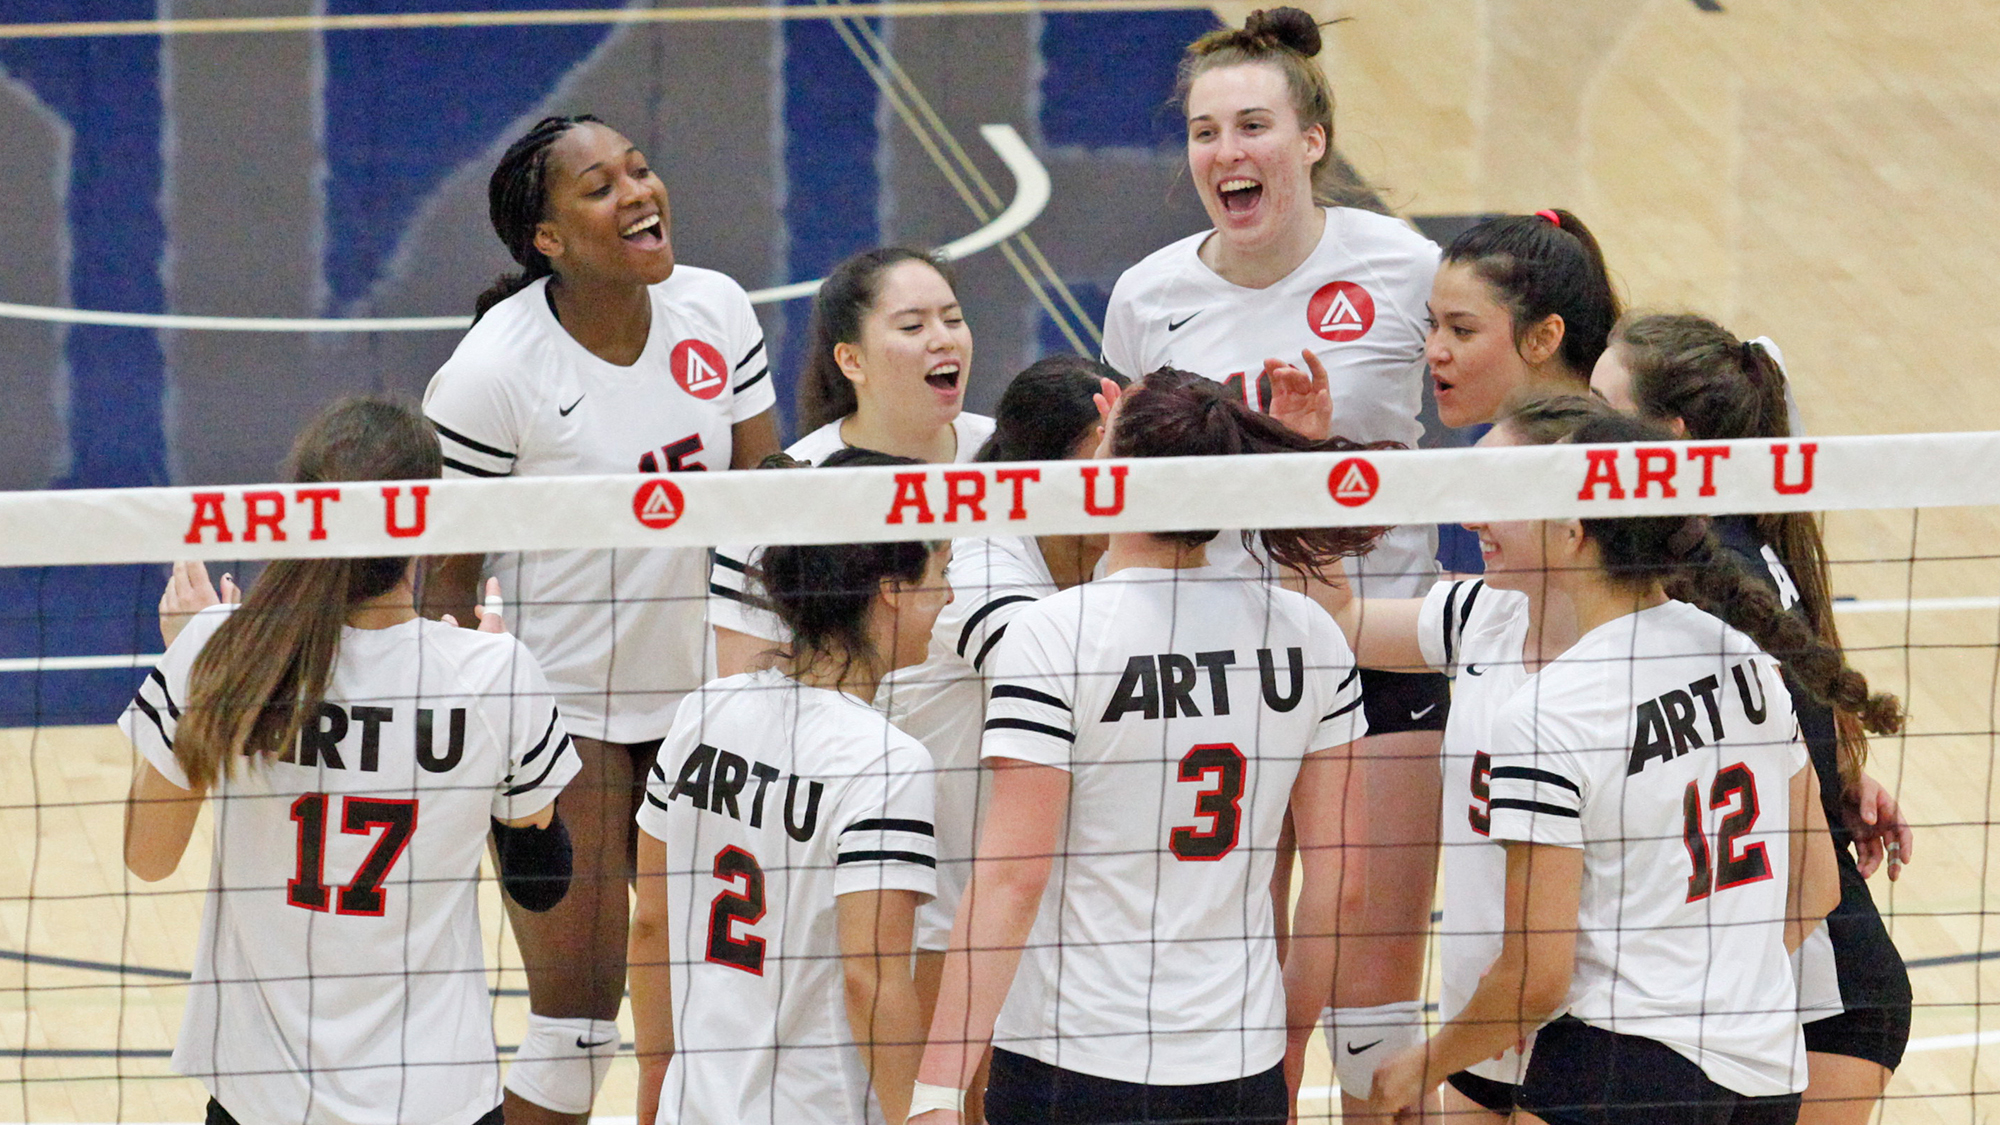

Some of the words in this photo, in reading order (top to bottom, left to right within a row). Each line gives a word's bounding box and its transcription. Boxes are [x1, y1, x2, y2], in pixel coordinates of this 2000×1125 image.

[637, 432, 708, 473] 5
[885, 468, 1041, 524] ART
[1080, 465, 1129, 517] U
[1577, 446, 1731, 501] ART
[1770, 443, 1818, 495] U
[184, 489, 341, 544] ART
[381, 486, 430, 538] U
[1100, 650, 1237, 723] ART
[1256, 647, 1304, 713] U
[1626, 674, 1726, 778] ART
[1731, 658, 1767, 725] U
[416, 707, 466, 773] U
[668, 743, 781, 830] ART
[784, 773, 825, 843] U
[1168, 742, 1248, 862] 3
[1682, 761, 1775, 904] 12
[286, 791, 420, 917] 17
[704, 843, 768, 978] 2
